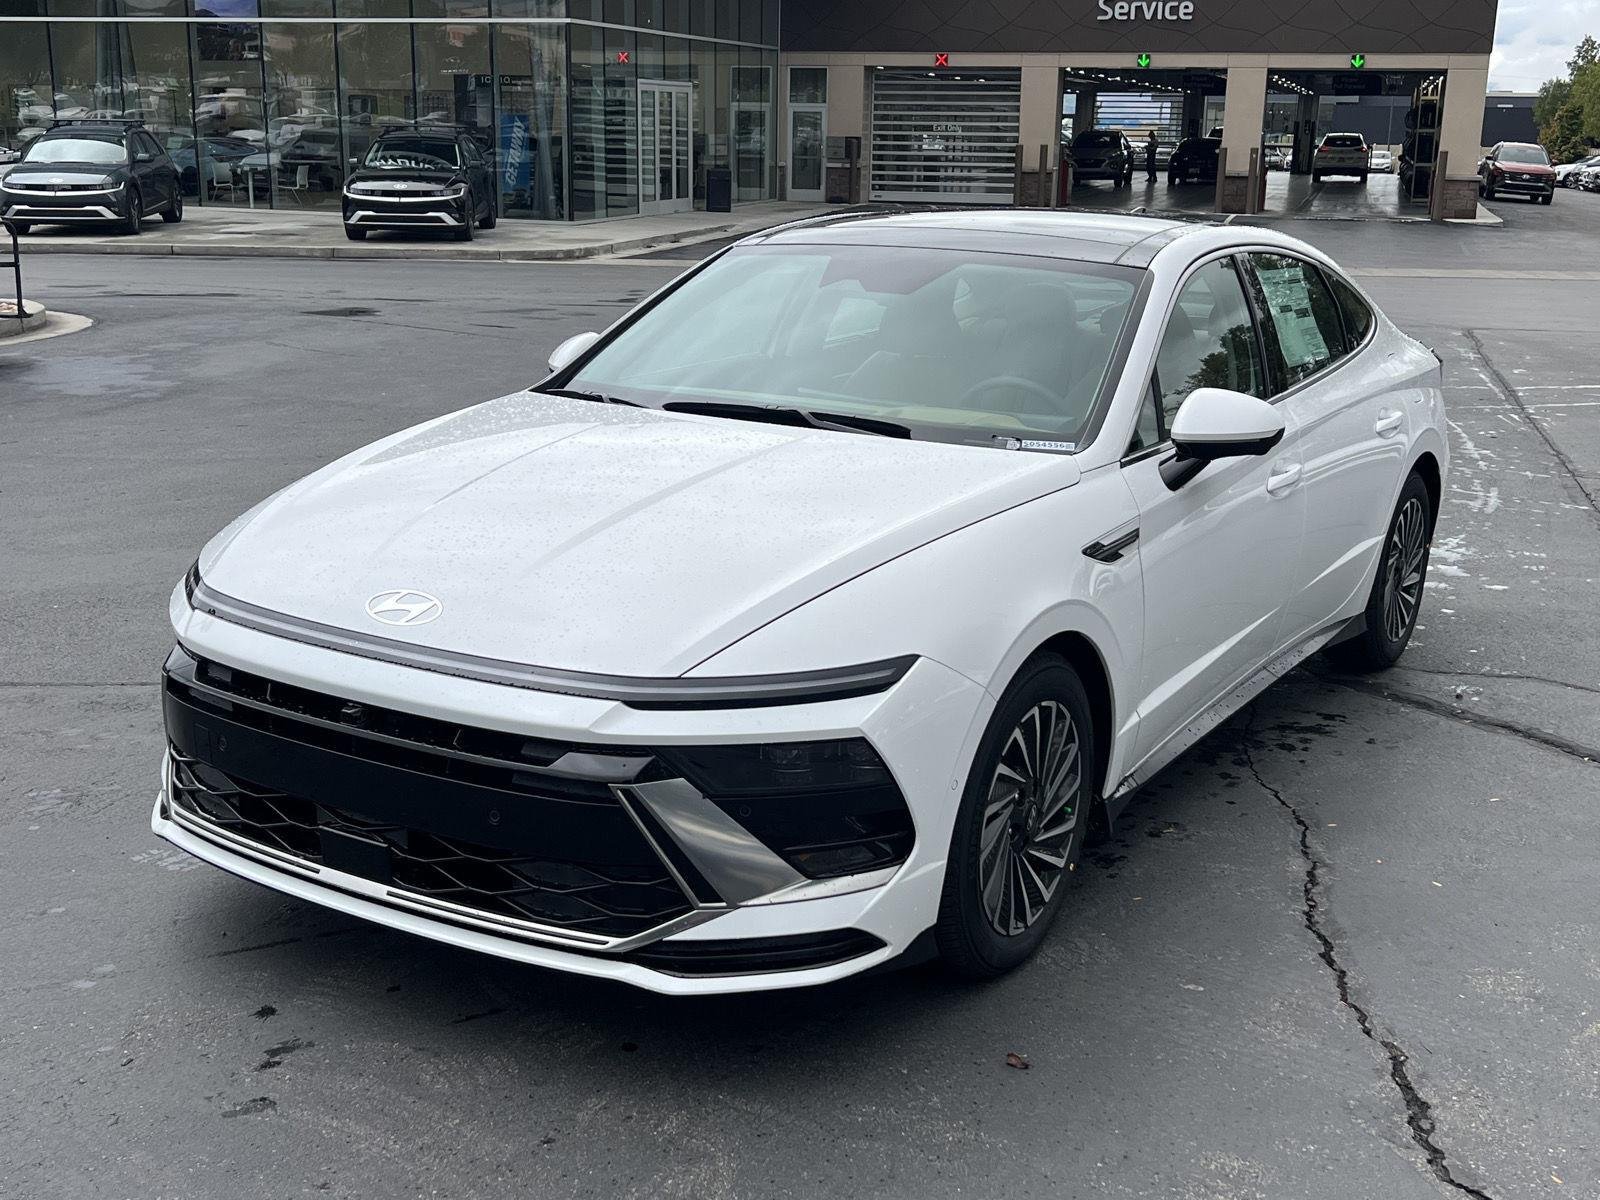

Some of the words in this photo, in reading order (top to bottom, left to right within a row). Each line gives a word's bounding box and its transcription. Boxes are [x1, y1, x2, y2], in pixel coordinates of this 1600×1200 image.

[1096, 0, 1194, 21] Service
[481, 76, 511, 84] IOIQ
[933, 123, 946, 132] Exit
[947, 123, 962, 134] Only
